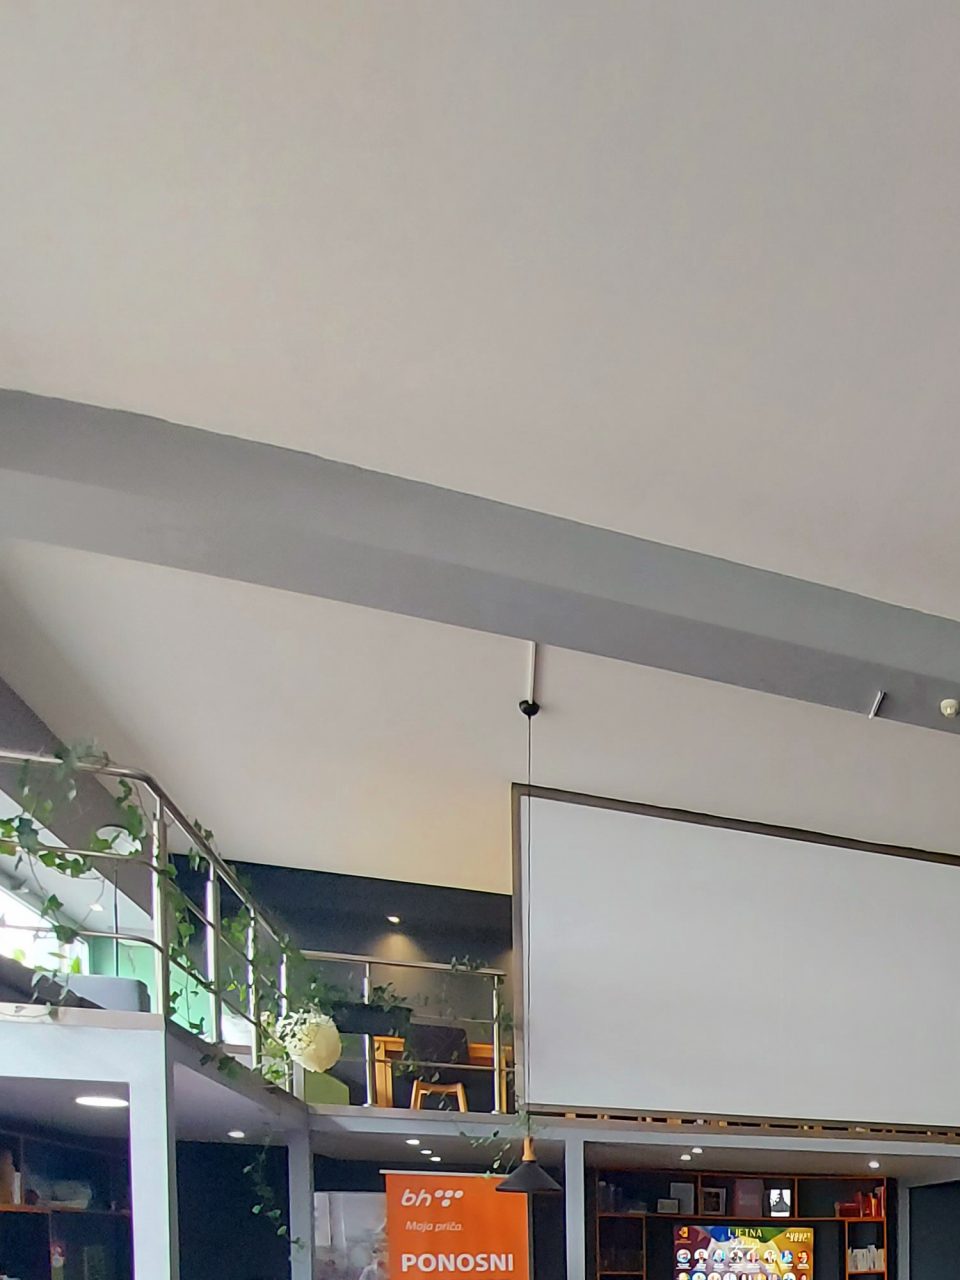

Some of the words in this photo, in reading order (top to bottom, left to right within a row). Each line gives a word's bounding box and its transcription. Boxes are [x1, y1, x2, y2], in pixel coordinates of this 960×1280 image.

[401, 1188, 432, 1207] bh
[405, 1220, 433, 1233] Moja
[728, 1228, 762, 1237] LJETNA
[401, 1253, 514, 1273] PONOSNI
